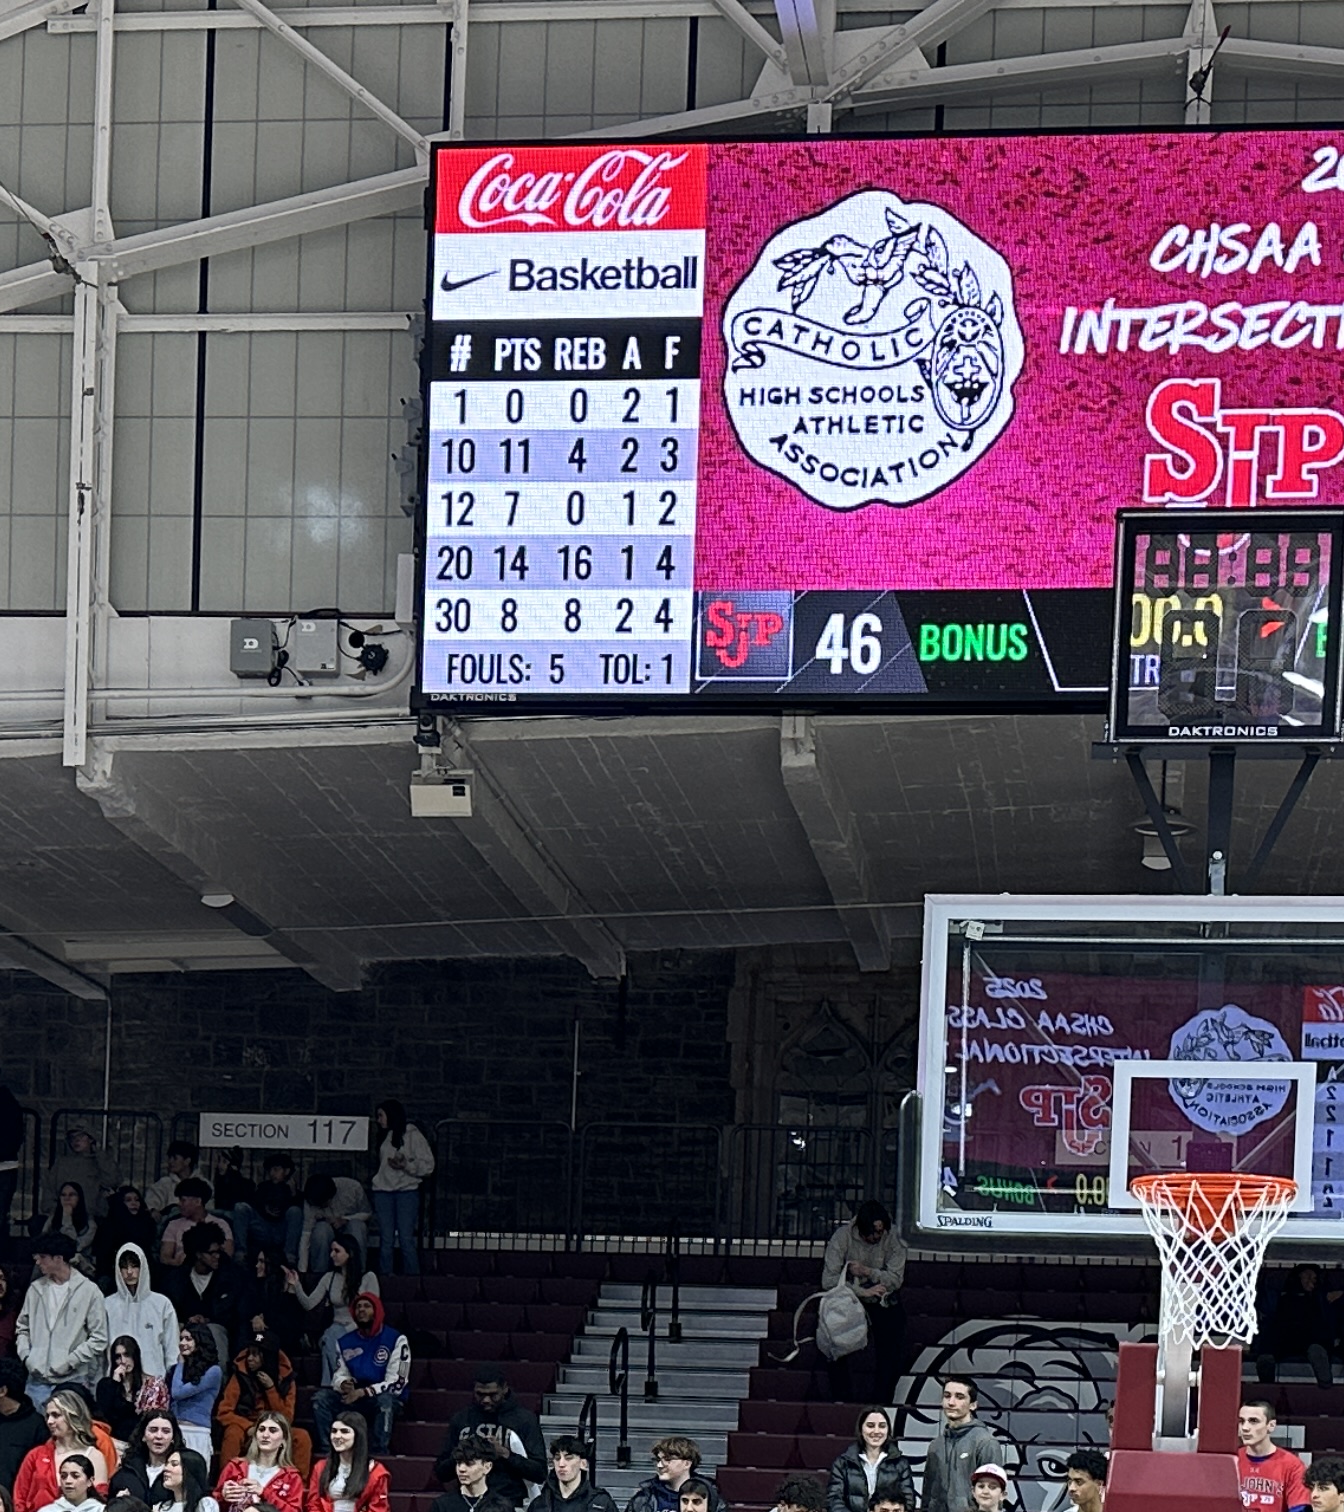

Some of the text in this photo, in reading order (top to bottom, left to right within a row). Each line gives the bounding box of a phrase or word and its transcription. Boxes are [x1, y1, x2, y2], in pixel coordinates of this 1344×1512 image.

[458, 150, 688, 227] Coca-Cola
[1149, 220, 1321, 276] CHSAA
[509, 257, 697, 291] Basketball
[450, 336, 680, 371] # PTS REB A F
[744, 317, 925, 362] CATHOLIC
[455, 388, 678, 424] 1 0 0 2 1
[740, 385, 925, 406] HIGH SCHOOLS
[794, 416, 925, 434] ATHLETIC
[443, 438, 678, 474] 10 11 4 2 3
[770, 433, 958, 489] ASSOCIATION
[436, 545, 675, 580] 20 14 16 1 4
[435, 598, 673, 632] 30 8 8 2 4
[815, 613, 882, 675] 46
[920, 625, 1028, 661] BONUS
[448, 654, 564, 685] FOULS: 5
[601, 653, 673, 684] TOL: 1
[431, 693, 517, 701] DAKTRONICS
[1169, 726, 1278, 736] DAKTRONICS
[212, 1119, 356, 1144] SECTION 117
[937, 1215, 994, 1228] SPALDING
